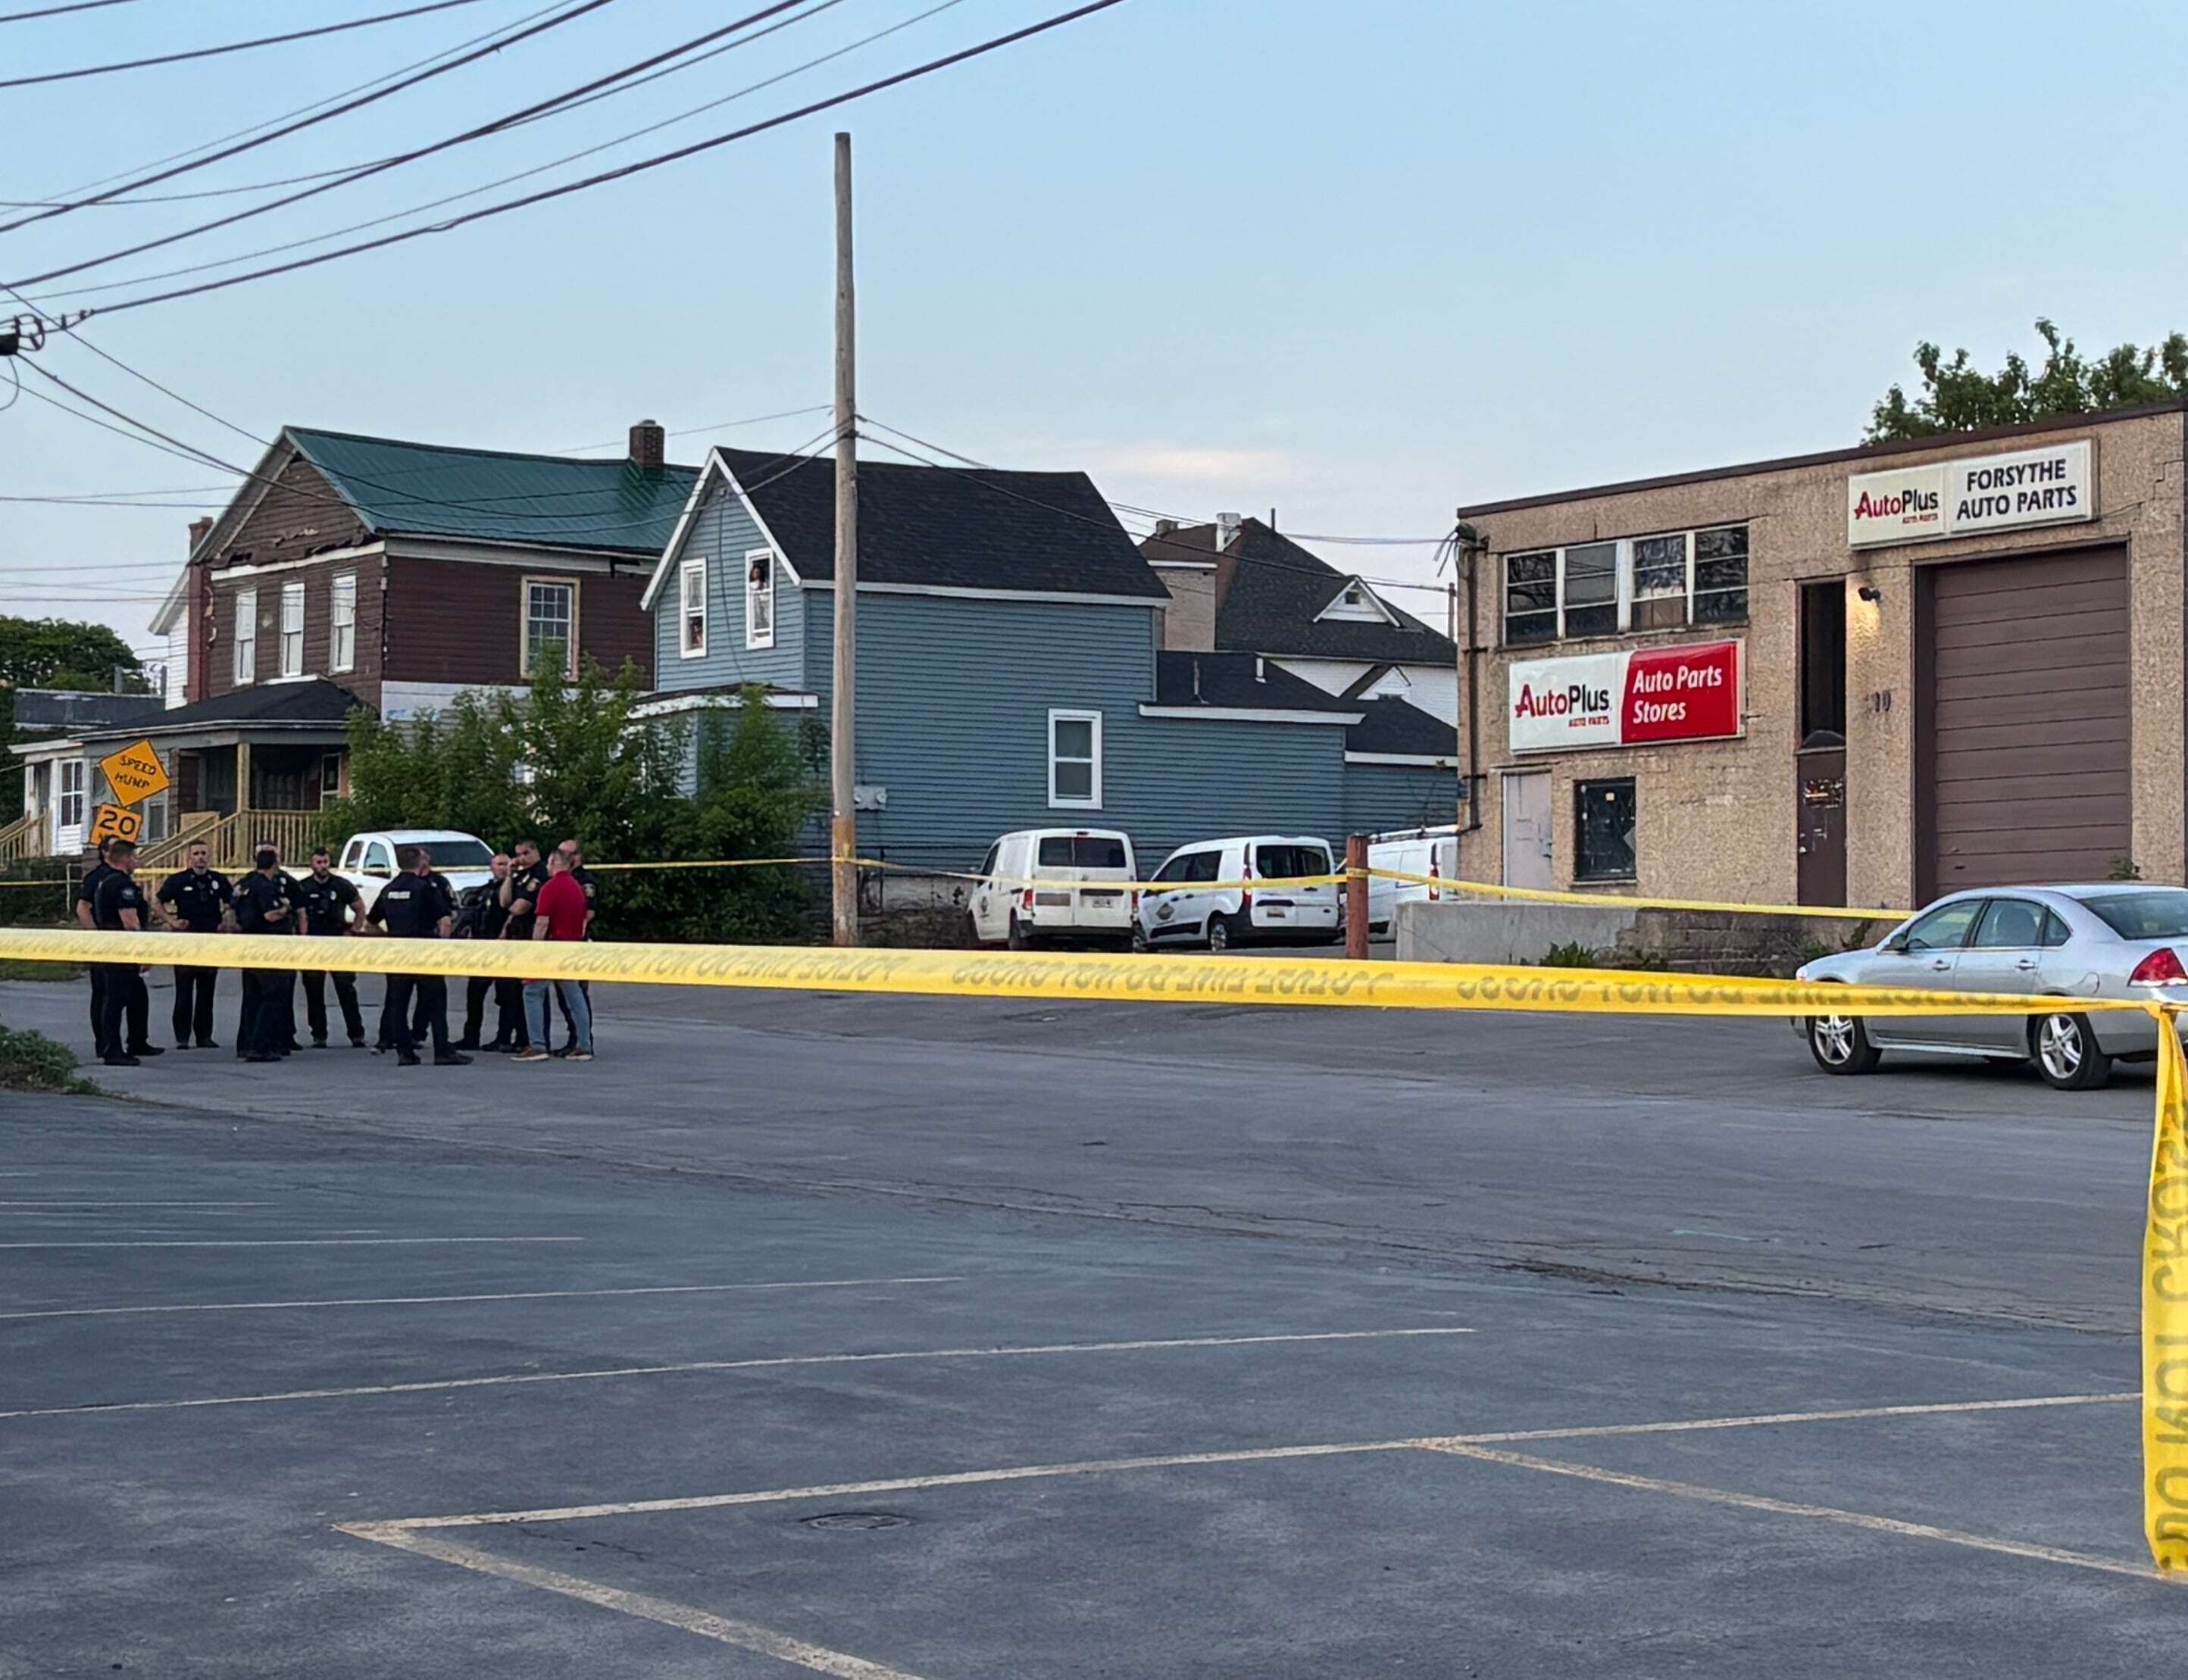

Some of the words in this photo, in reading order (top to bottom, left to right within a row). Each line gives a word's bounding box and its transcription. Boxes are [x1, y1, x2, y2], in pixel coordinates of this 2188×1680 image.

[1967, 458, 2066, 492] FORSYTHE
[1854, 489, 1939, 520] AutoPlus
[1957, 495, 2010, 520] AUTO
[2017, 485, 2077, 513] PARTS
[1633, 670, 1672, 694] Auto
[1677, 665, 1723, 690] Parts
[1514, 683, 1610, 718] AutoPlus
[1633, 700, 1686, 725] Stores
[119, 754, 157, 776] SPEED
[115, 772, 151, 789] HUMP
[99, 810, 136, 835] 20
